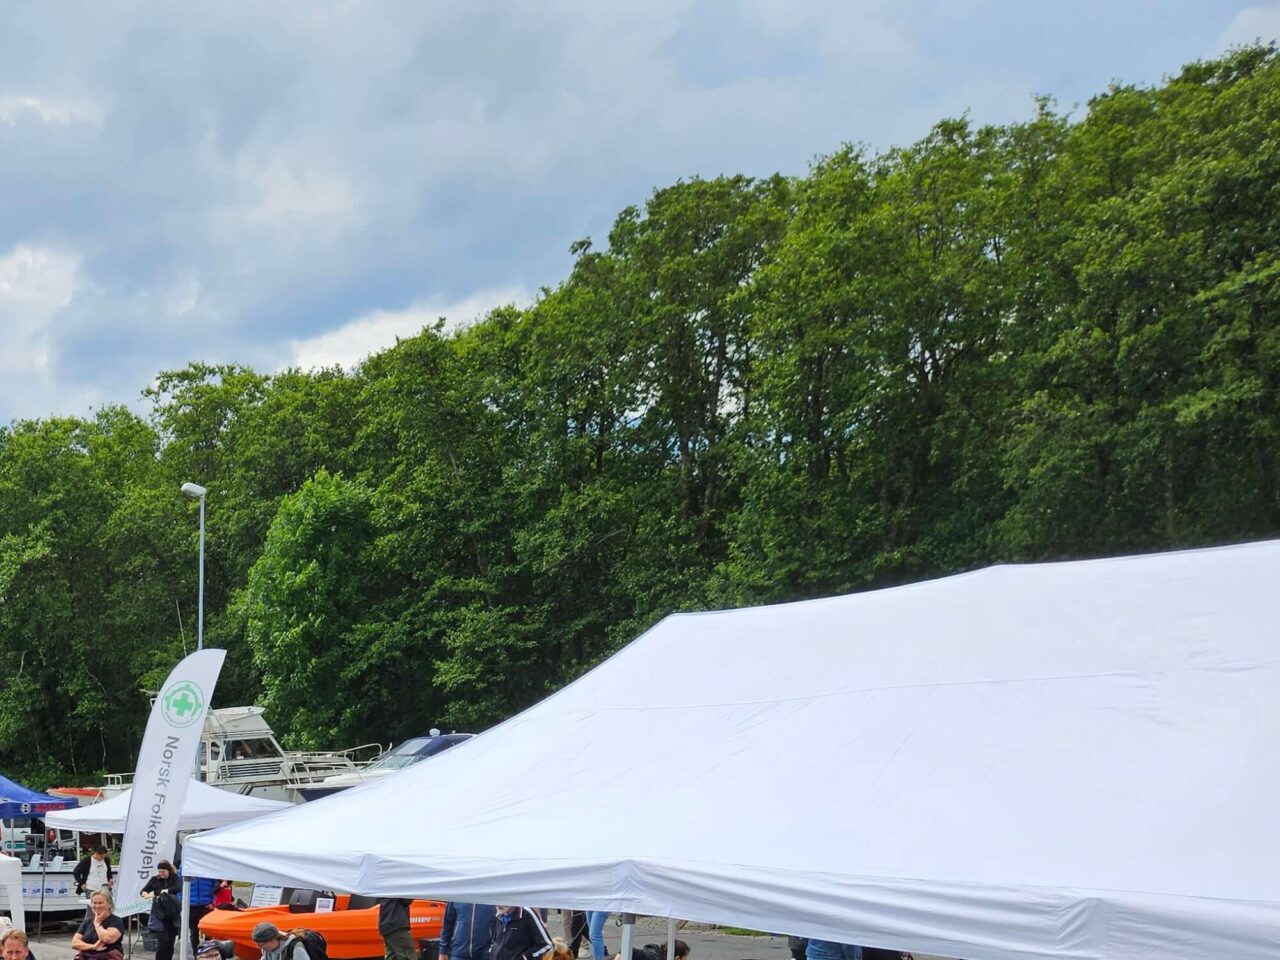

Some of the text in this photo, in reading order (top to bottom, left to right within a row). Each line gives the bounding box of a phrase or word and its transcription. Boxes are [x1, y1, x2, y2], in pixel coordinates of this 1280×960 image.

[35, 803, 65, 812] BOSCH
[137, 735, 180, 881] Norsk Folkehjelp
